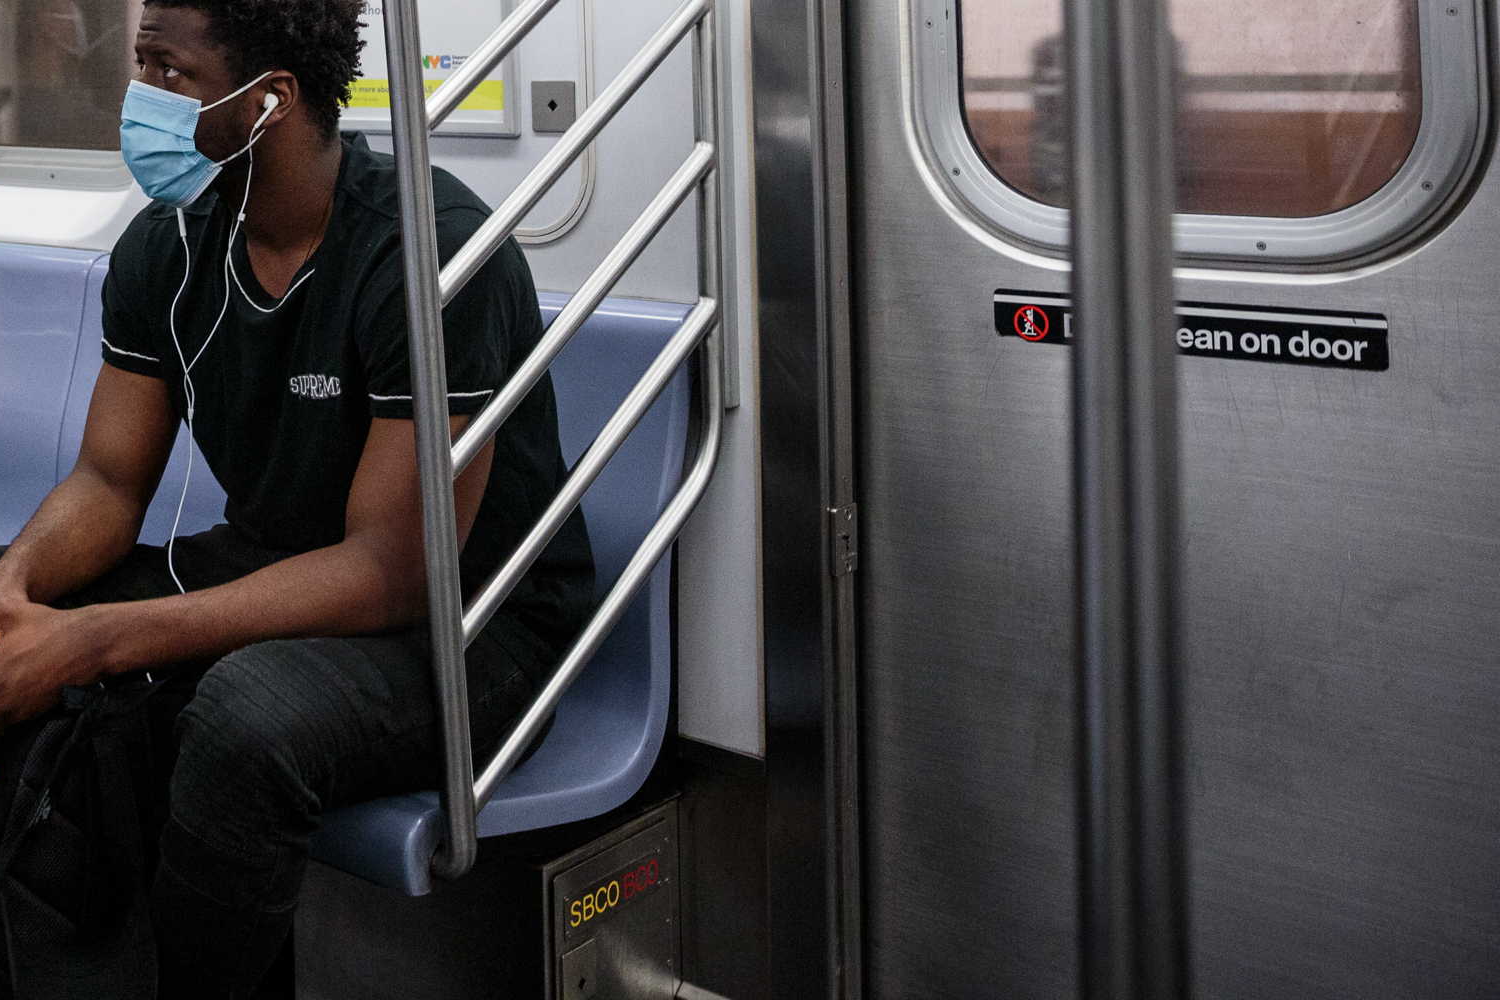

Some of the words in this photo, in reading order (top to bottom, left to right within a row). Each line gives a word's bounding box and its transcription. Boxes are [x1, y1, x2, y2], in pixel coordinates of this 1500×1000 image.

[1175, 327, 1234, 352] ean
[1239, 331, 1281, 355] on
[1288, 329, 1368, 362] door
[289, 374, 342, 399] SUPREME
[570, 880, 620, 928] SBCO
[623, 859, 659, 899] BCO
